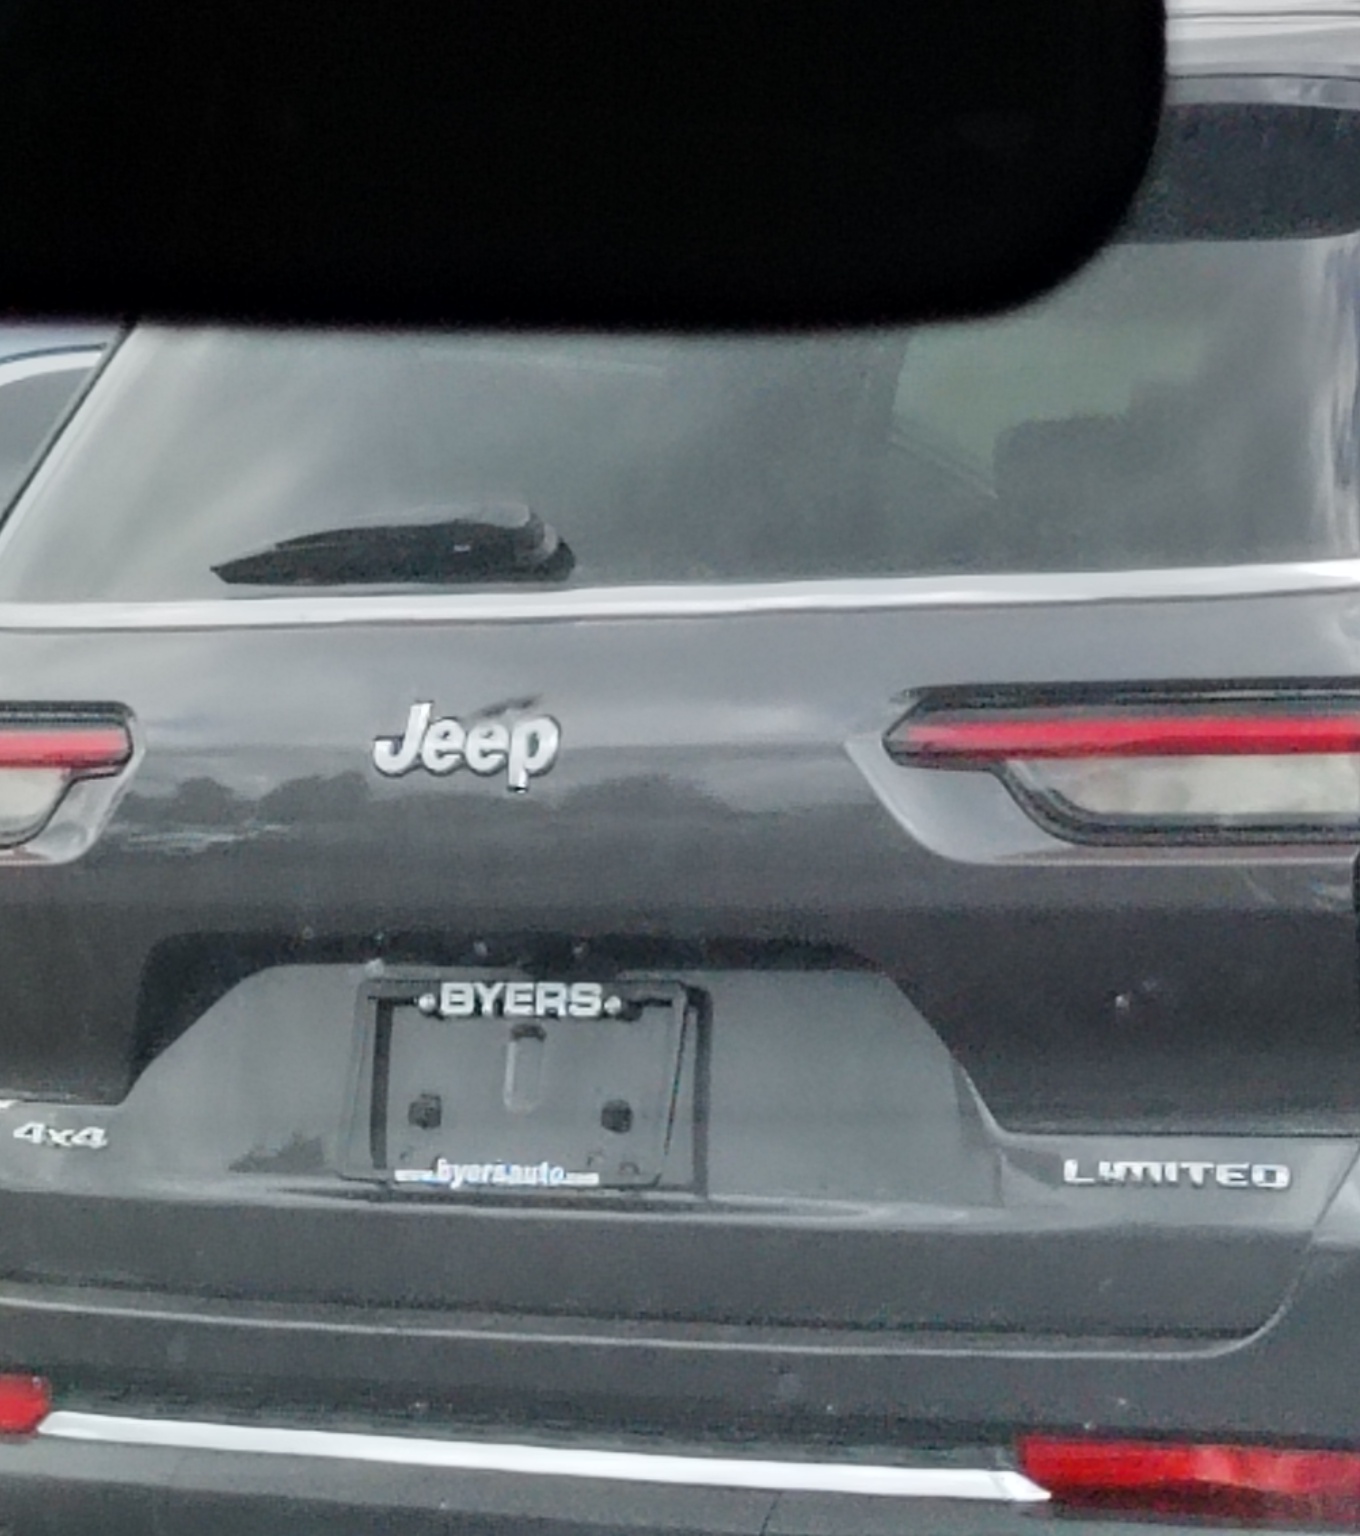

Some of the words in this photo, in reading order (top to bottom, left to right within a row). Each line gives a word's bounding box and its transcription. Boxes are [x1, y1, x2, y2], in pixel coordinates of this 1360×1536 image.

[374, 700, 561, 792] Jeep
[440, 981, 603, 1017] BYERS
[12, 1120, 109, 1150] 4x4
[435, 1158, 567, 1190] byersauto
[1063, 1158, 1292, 1190] LIMITED
